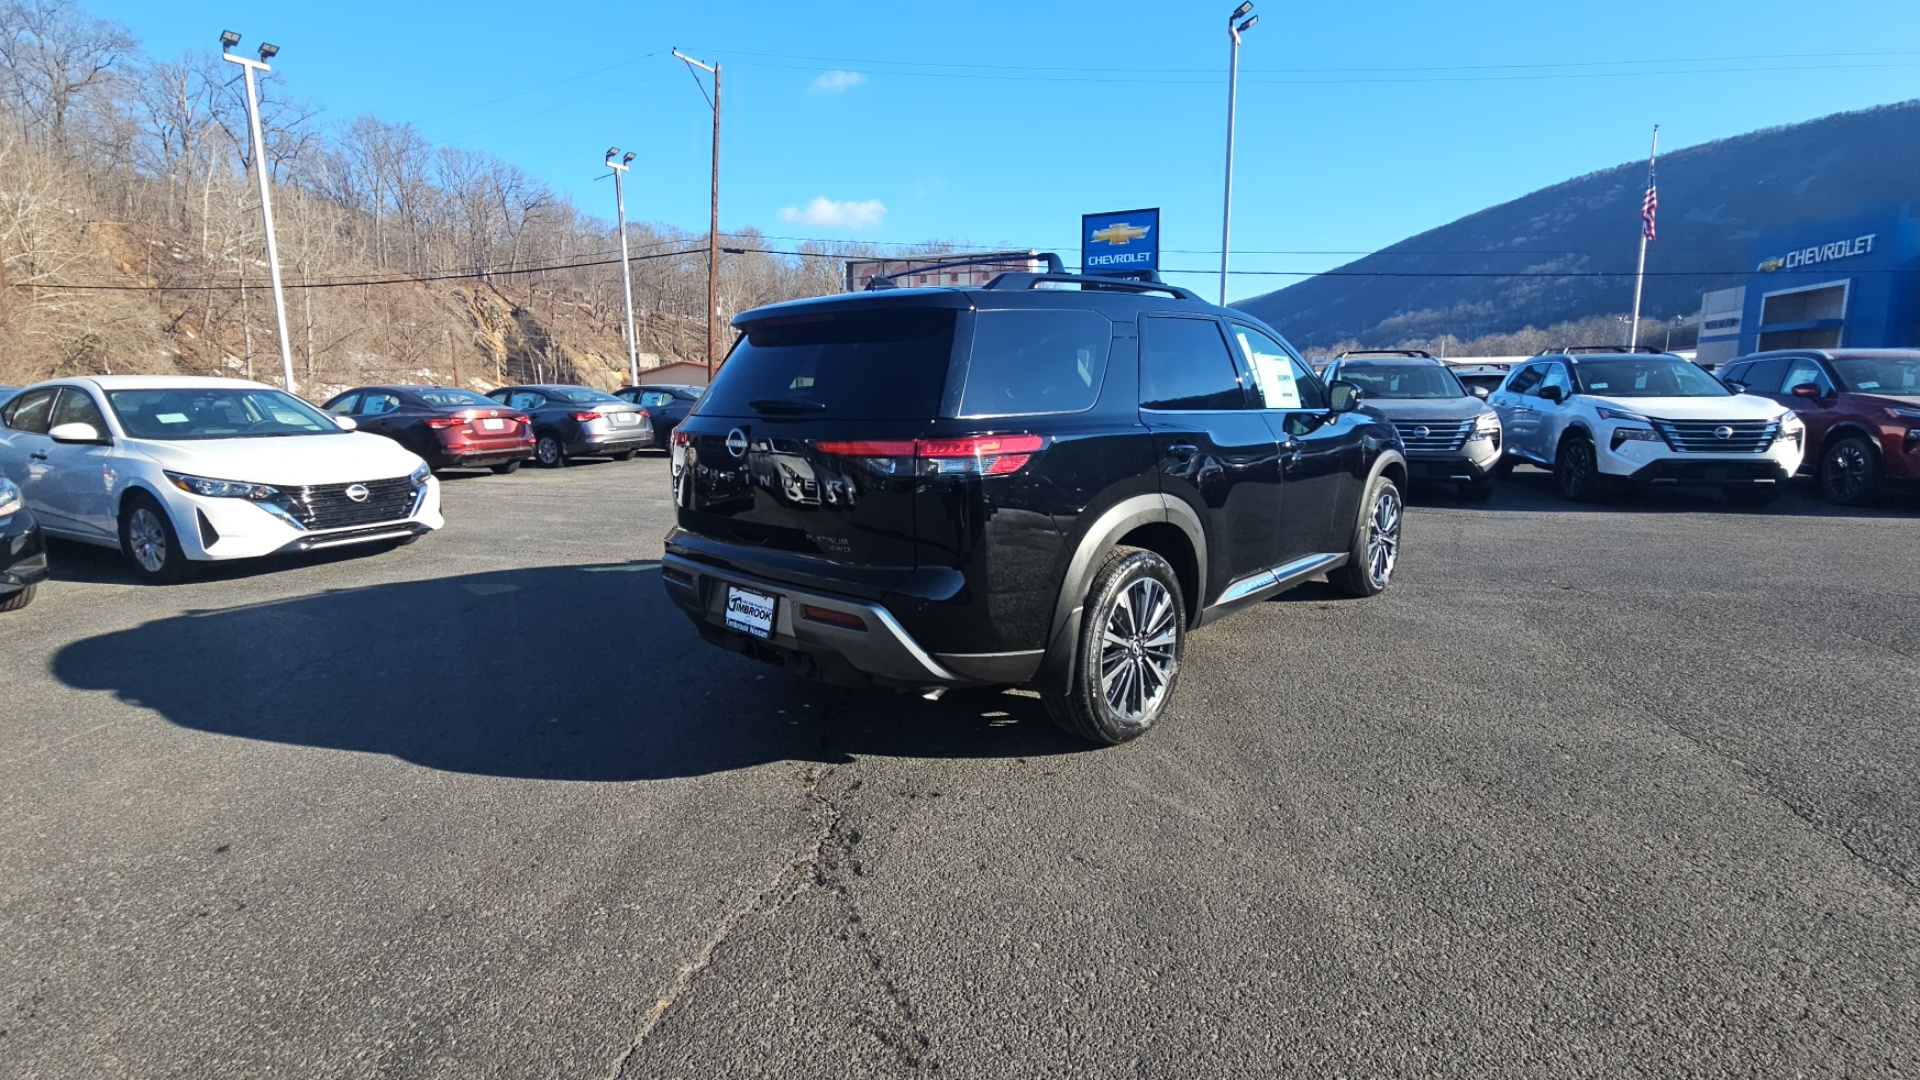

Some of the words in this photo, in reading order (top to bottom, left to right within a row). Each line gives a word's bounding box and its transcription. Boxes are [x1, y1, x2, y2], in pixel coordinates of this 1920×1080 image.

[1088, 252, 1152, 266] CHEVROLET
[1786, 233, 1876, 268] CHEVROLET
[675, 463, 843, 493] PATHFINDER
[805, 534, 849, 545] PLATINUM
[829, 545, 851, 553] 4WD
[727, 594, 772, 622] TIMBROOK
[726, 618, 749, 632] Timbrook
[749, 626, 768, 639] Nissan
